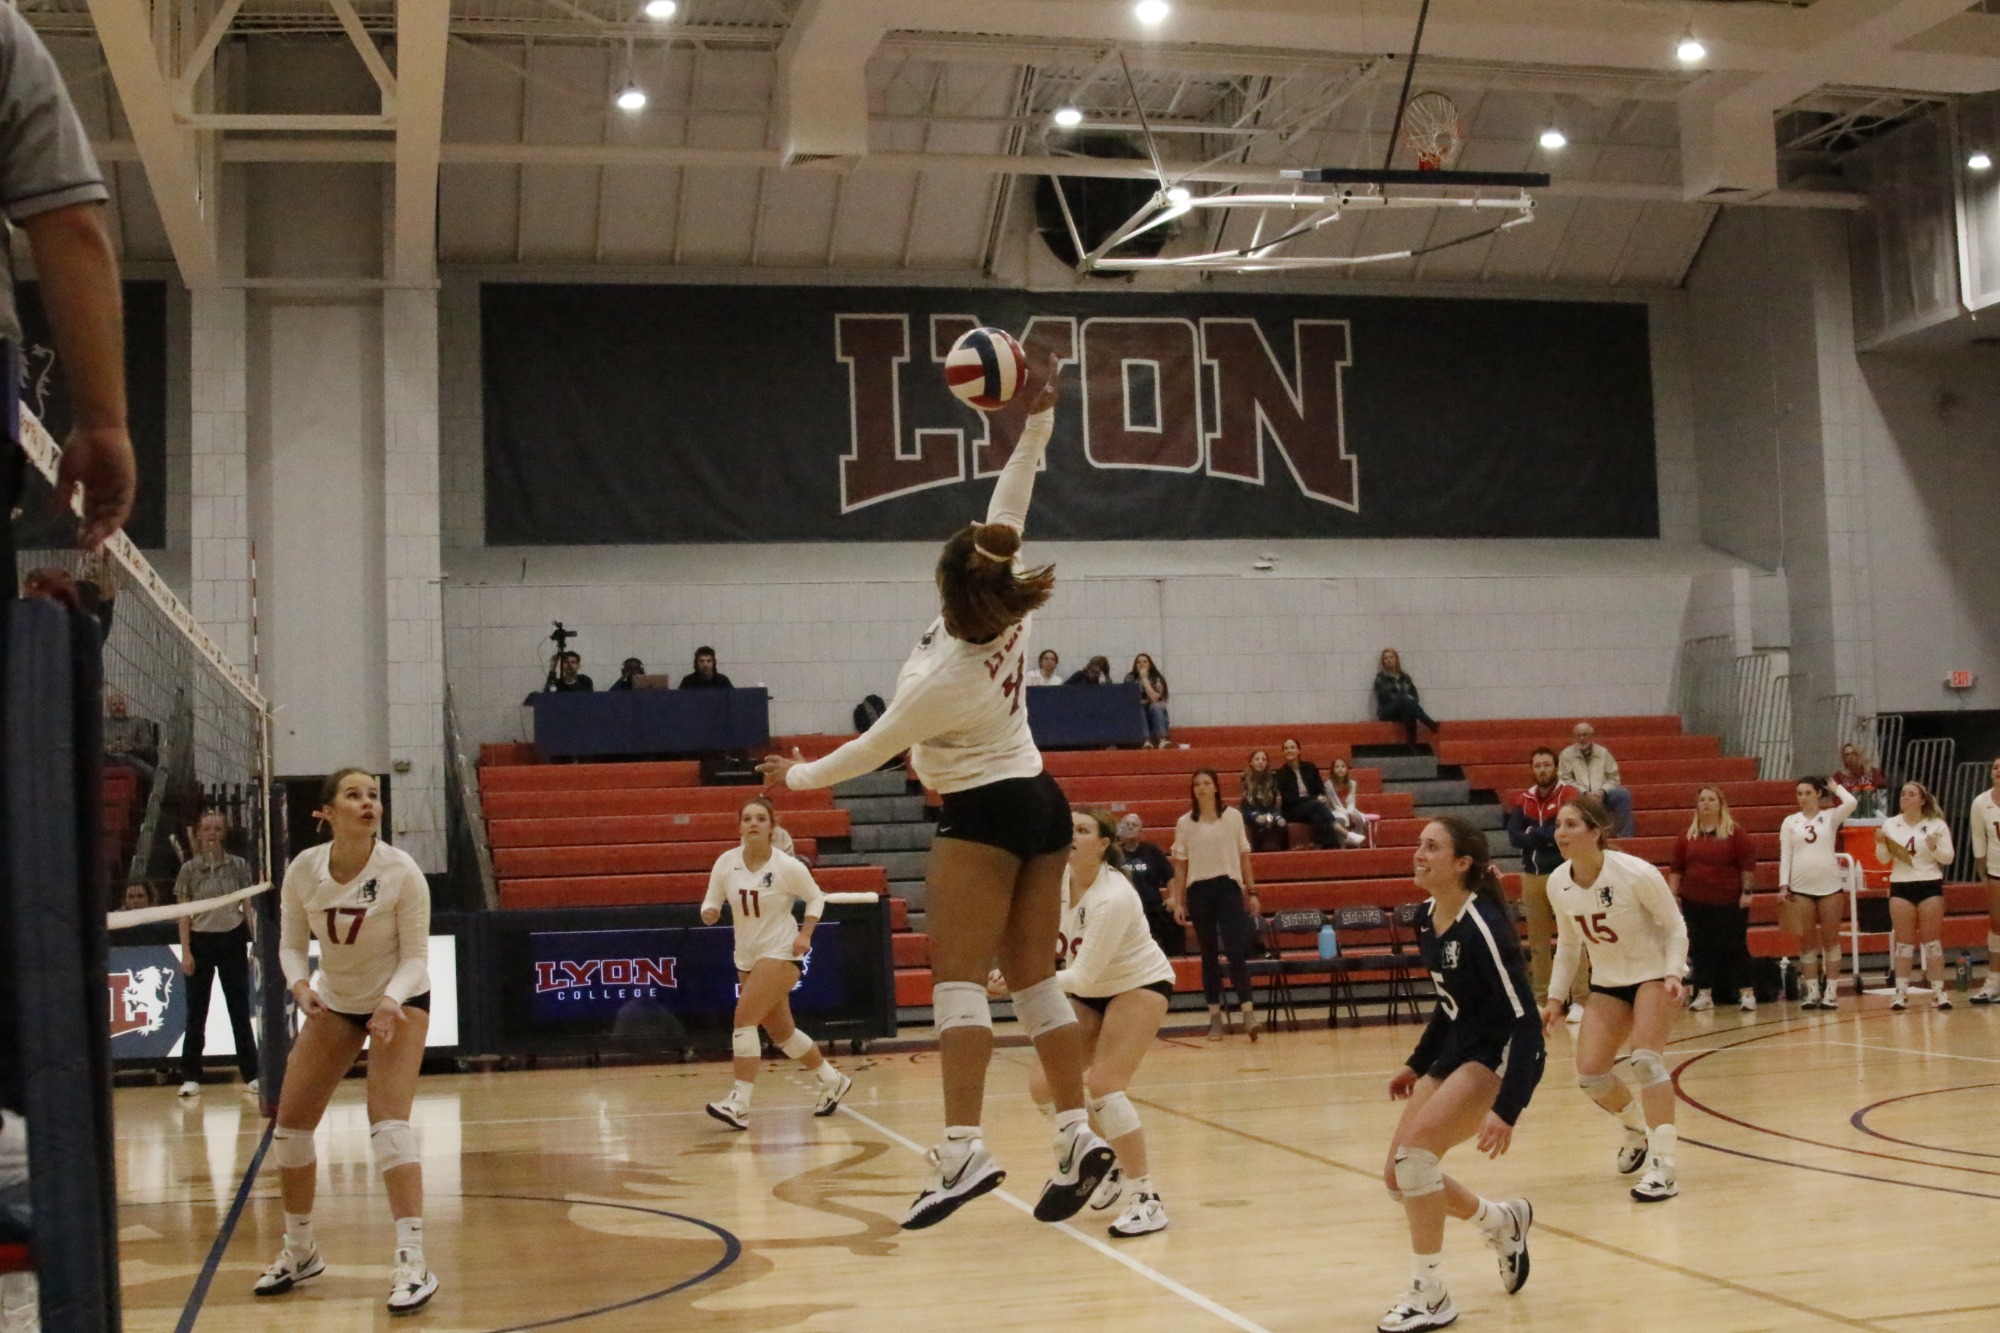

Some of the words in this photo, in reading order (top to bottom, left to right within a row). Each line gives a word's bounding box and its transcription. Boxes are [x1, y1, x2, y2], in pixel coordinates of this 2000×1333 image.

[834, 312, 1360, 514] LYON
[1952, 671, 1969, 686] EXIT
[1804, 825, 1817, 844] 3
[1905, 836, 1917, 857] 4
[738, 889, 761, 918] 11
[323, 907, 368, 945] 17
[1574, 912, 1619, 944] 15
[535, 957, 677, 993] LYON
[557, 988, 656, 1000] COLLEGE
